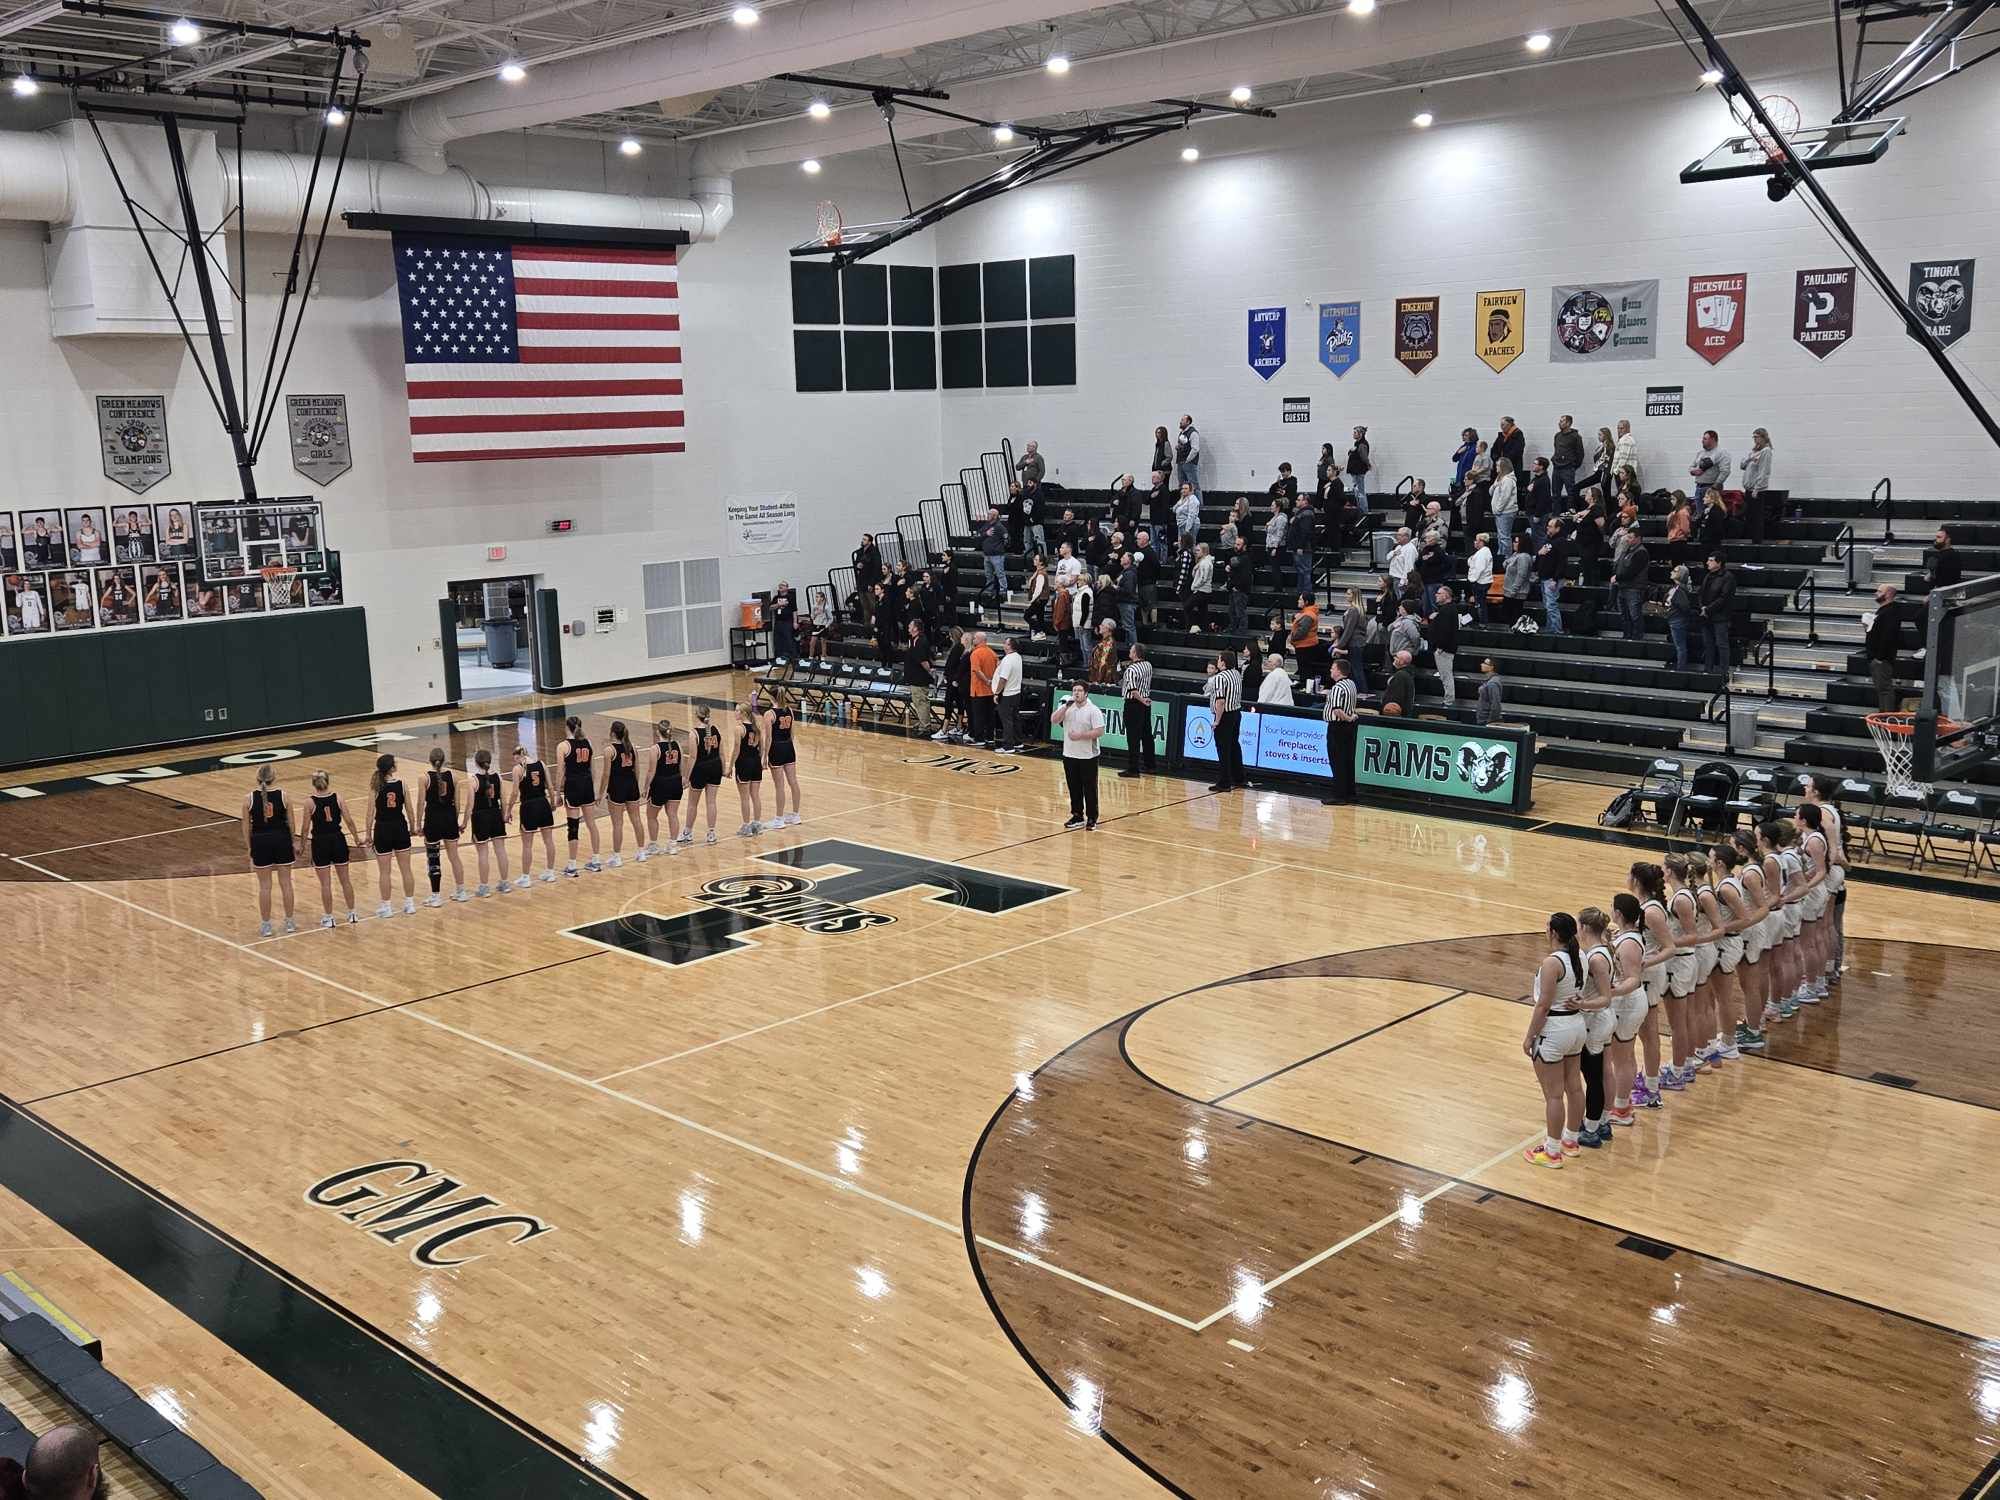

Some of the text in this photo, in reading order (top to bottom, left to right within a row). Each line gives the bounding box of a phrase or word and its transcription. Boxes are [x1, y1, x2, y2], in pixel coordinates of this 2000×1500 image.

[1923, 265, 1960, 278] TINORA
[1803, 272, 1848, 286] PAULDING
[1692, 279, 1743, 293] HICKSVILLE
[1483, 295, 1518, 306] FAIRVIEW
[1400, 301, 1434, 313] EDGERTON
[1805, 291, 1835, 328] P
[1253, 310, 1281, 322] ANTWERP
[1704, 335, 1726, 347] ACES
[1799, 329, 1846, 343] PANTHERS
[1400, 349, 1433, 361] BULLDOGS
[1484, 345, 1515, 356] APACHES
[1254, 356, 1281, 367] ARCHERS
[101, 399, 161, 409] GREEN MEADOWS
[290, 398, 342, 407] GREEN MEADOWS
[108, 409, 156, 419] CONFERENCE
[296, 407, 337, 416] CONFERENCE
[1648, 404, 1680, 415] GUESTS
[1284, 413, 1309, 422] GUESTS
[113, 454, 162, 465] CHAMPIONS
[310, 449, 333, 459] GIRLS
[1264, 725, 1280, 735] Your
[1280, 727, 1297, 737] local
[1297, 730, 1324, 742] provider
[1278, 738, 1319, 752] fireplaces,
[575, 747, 590, 763] 10
[1264, 750, 1290, 761] stoves
[1291, 752, 1298, 761] &
[1362, 736, 1452, 783] RAMS
[303, 1158, 559, 1270] GMC
